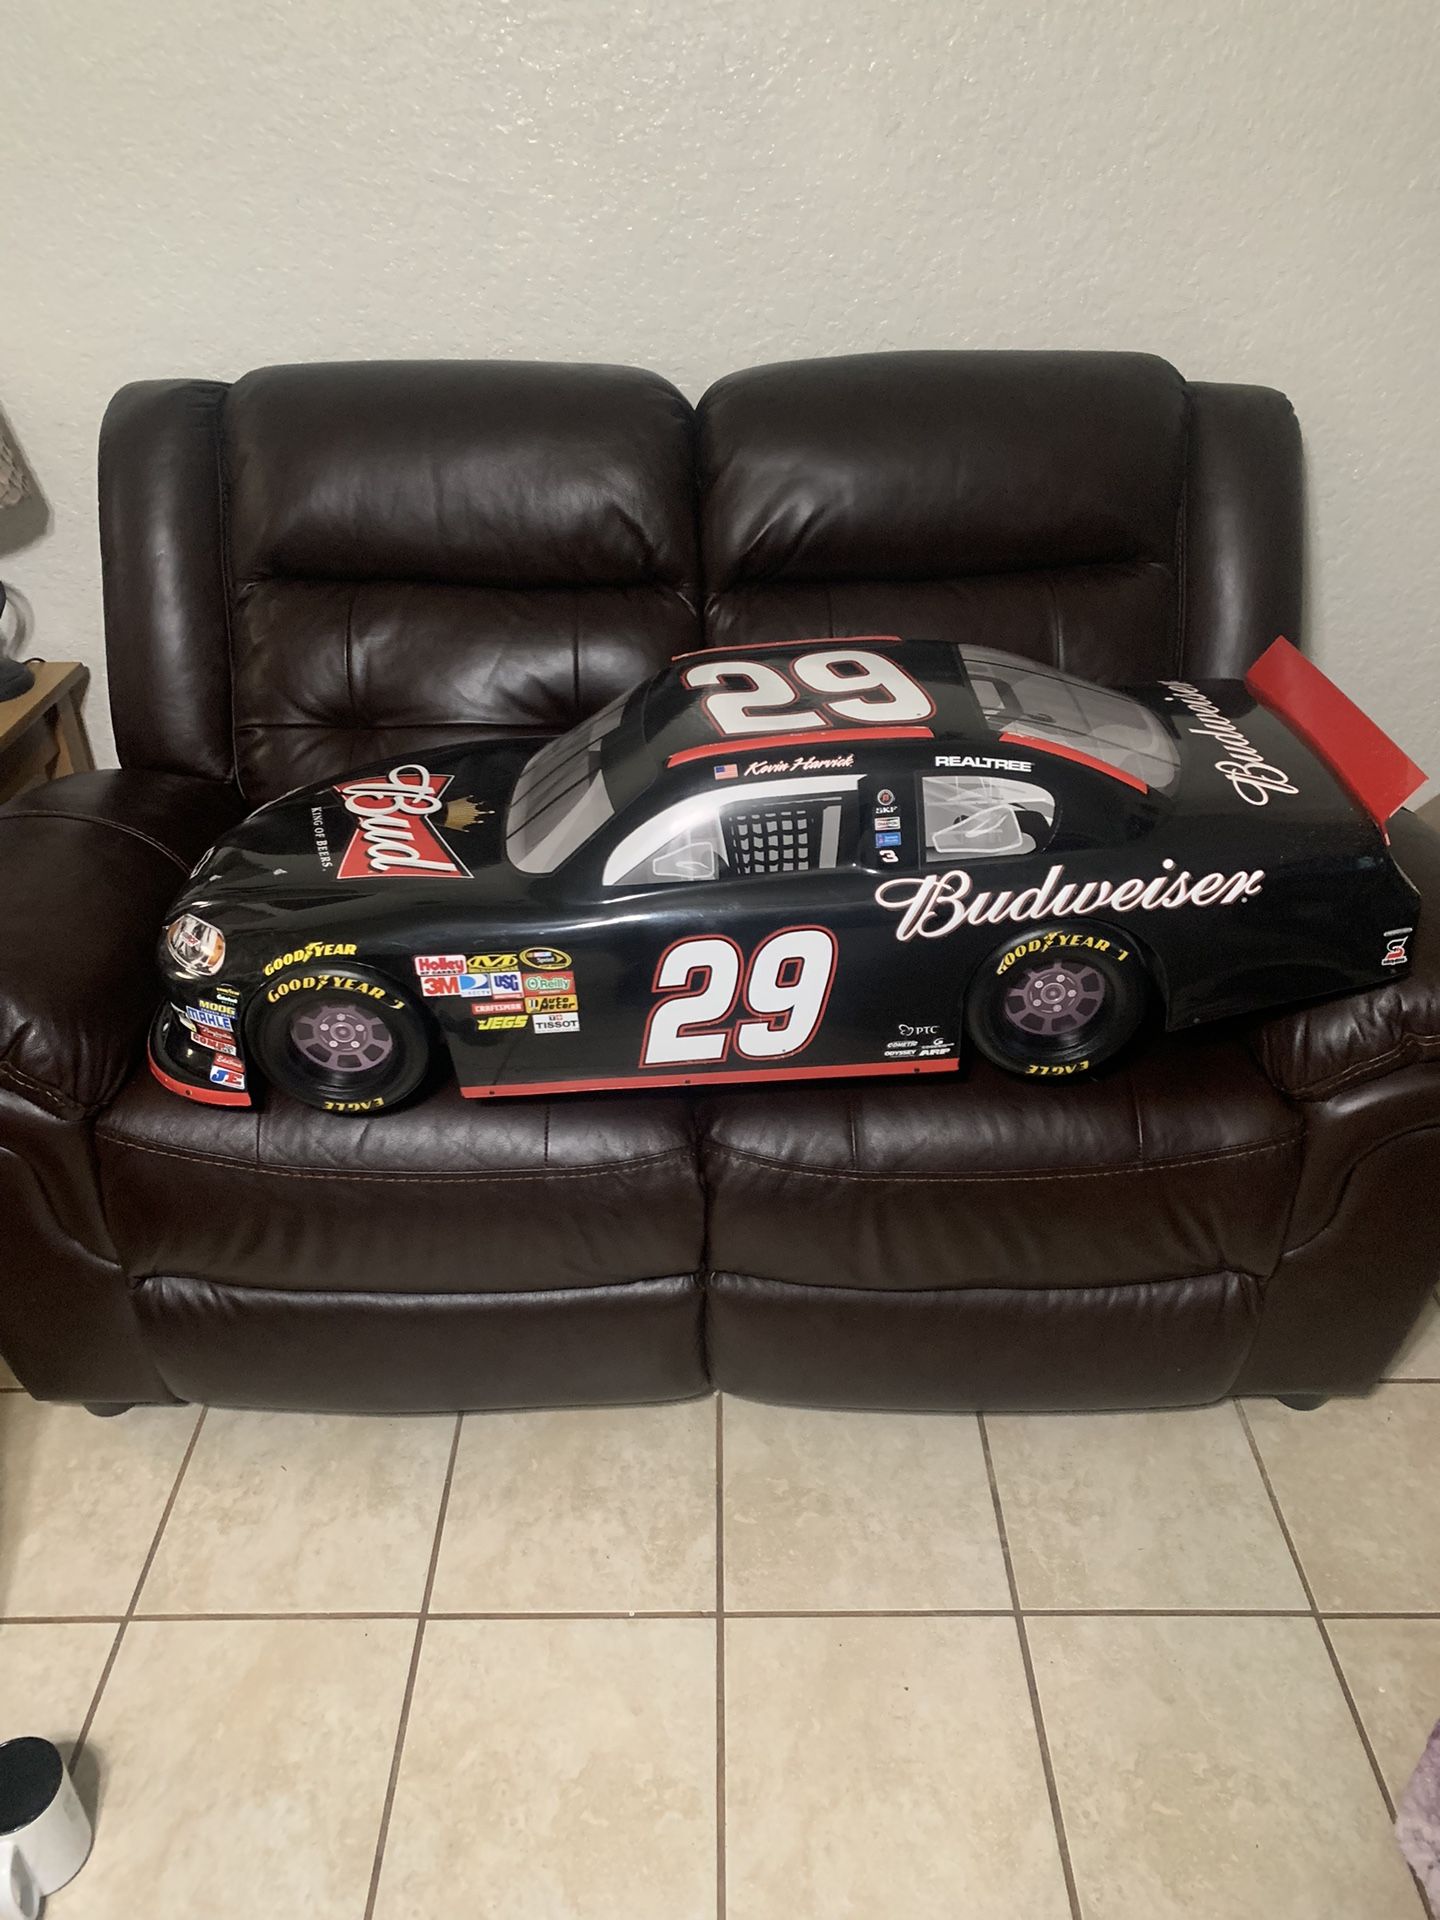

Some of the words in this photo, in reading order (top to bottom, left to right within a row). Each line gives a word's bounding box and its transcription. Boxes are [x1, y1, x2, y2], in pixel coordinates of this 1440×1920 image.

[681, 650, 937, 736] 29
[744, 760, 790, 776] Kevin
[789, 753, 856, 772] Harvick
[935, 756, 1033, 773] REALTREE
[311, 806, 323, 826] KING
[341, 764, 458, 872] Bud
[314, 827, 326, 838] OF
[875, 858, 1266, 942] Budweiser
[418, 957, 464, 974] Holley
[424, 976, 460, 994] 3M
[494, 975, 519, 991] USG
[526, 976, 570, 990] O'Reilly
[638, 925, 839, 1068] 29
[199, 1000, 236, 1015] MOOG
[188, 1007, 231, 1030] MAHLE
[478, 1015, 529, 1030] JEGS
[536, 1020, 577, 1029] TISSOT
[916, 1026, 939, 1035] PTC
[1025, 1060, 1089, 1075] EAGLE
[212, 1069, 243, 1085] JE
[323, 1097, 384, 1111] EAGLE
